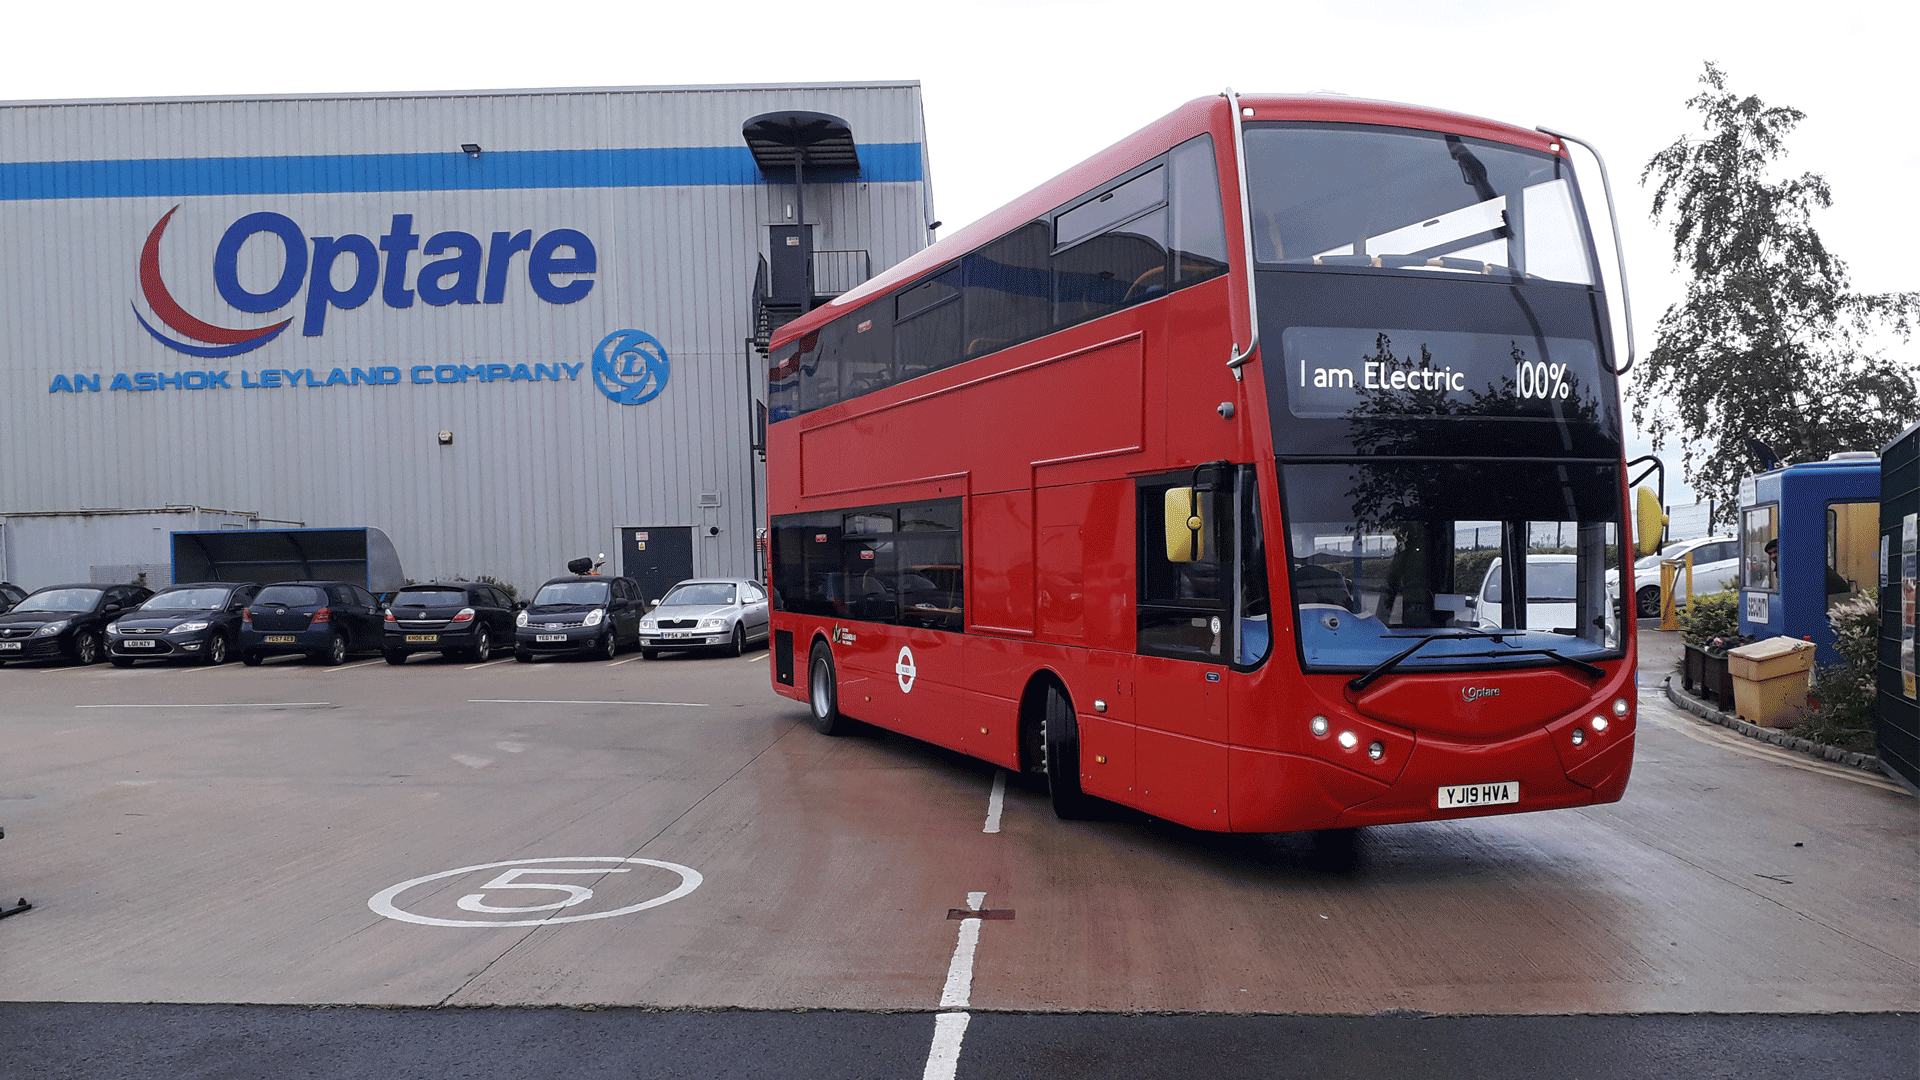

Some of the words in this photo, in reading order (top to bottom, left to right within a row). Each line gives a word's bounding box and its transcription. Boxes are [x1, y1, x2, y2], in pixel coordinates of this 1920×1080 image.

[213, 211, 597, 337] Optare
[50, 373, 100, 393] AN
[110, 370, 231, 391] ASHOK
[241, 366, 401, 388] LEYLAND
[411, 362, 584, 383] COMPANY
[1300, 359, 1306, 387] I
[1313, 367, 1354, 389] am
[1363, 361, 1465, 391] Electric
[1515, 360, 1570, 400] 100%
[1468, 686, 1501, 700] Optare
[1446, 786, 1479, 805] YJ19
[1482, 784, 1509, 802] HVA
[456, 867, 632, 914] 5
